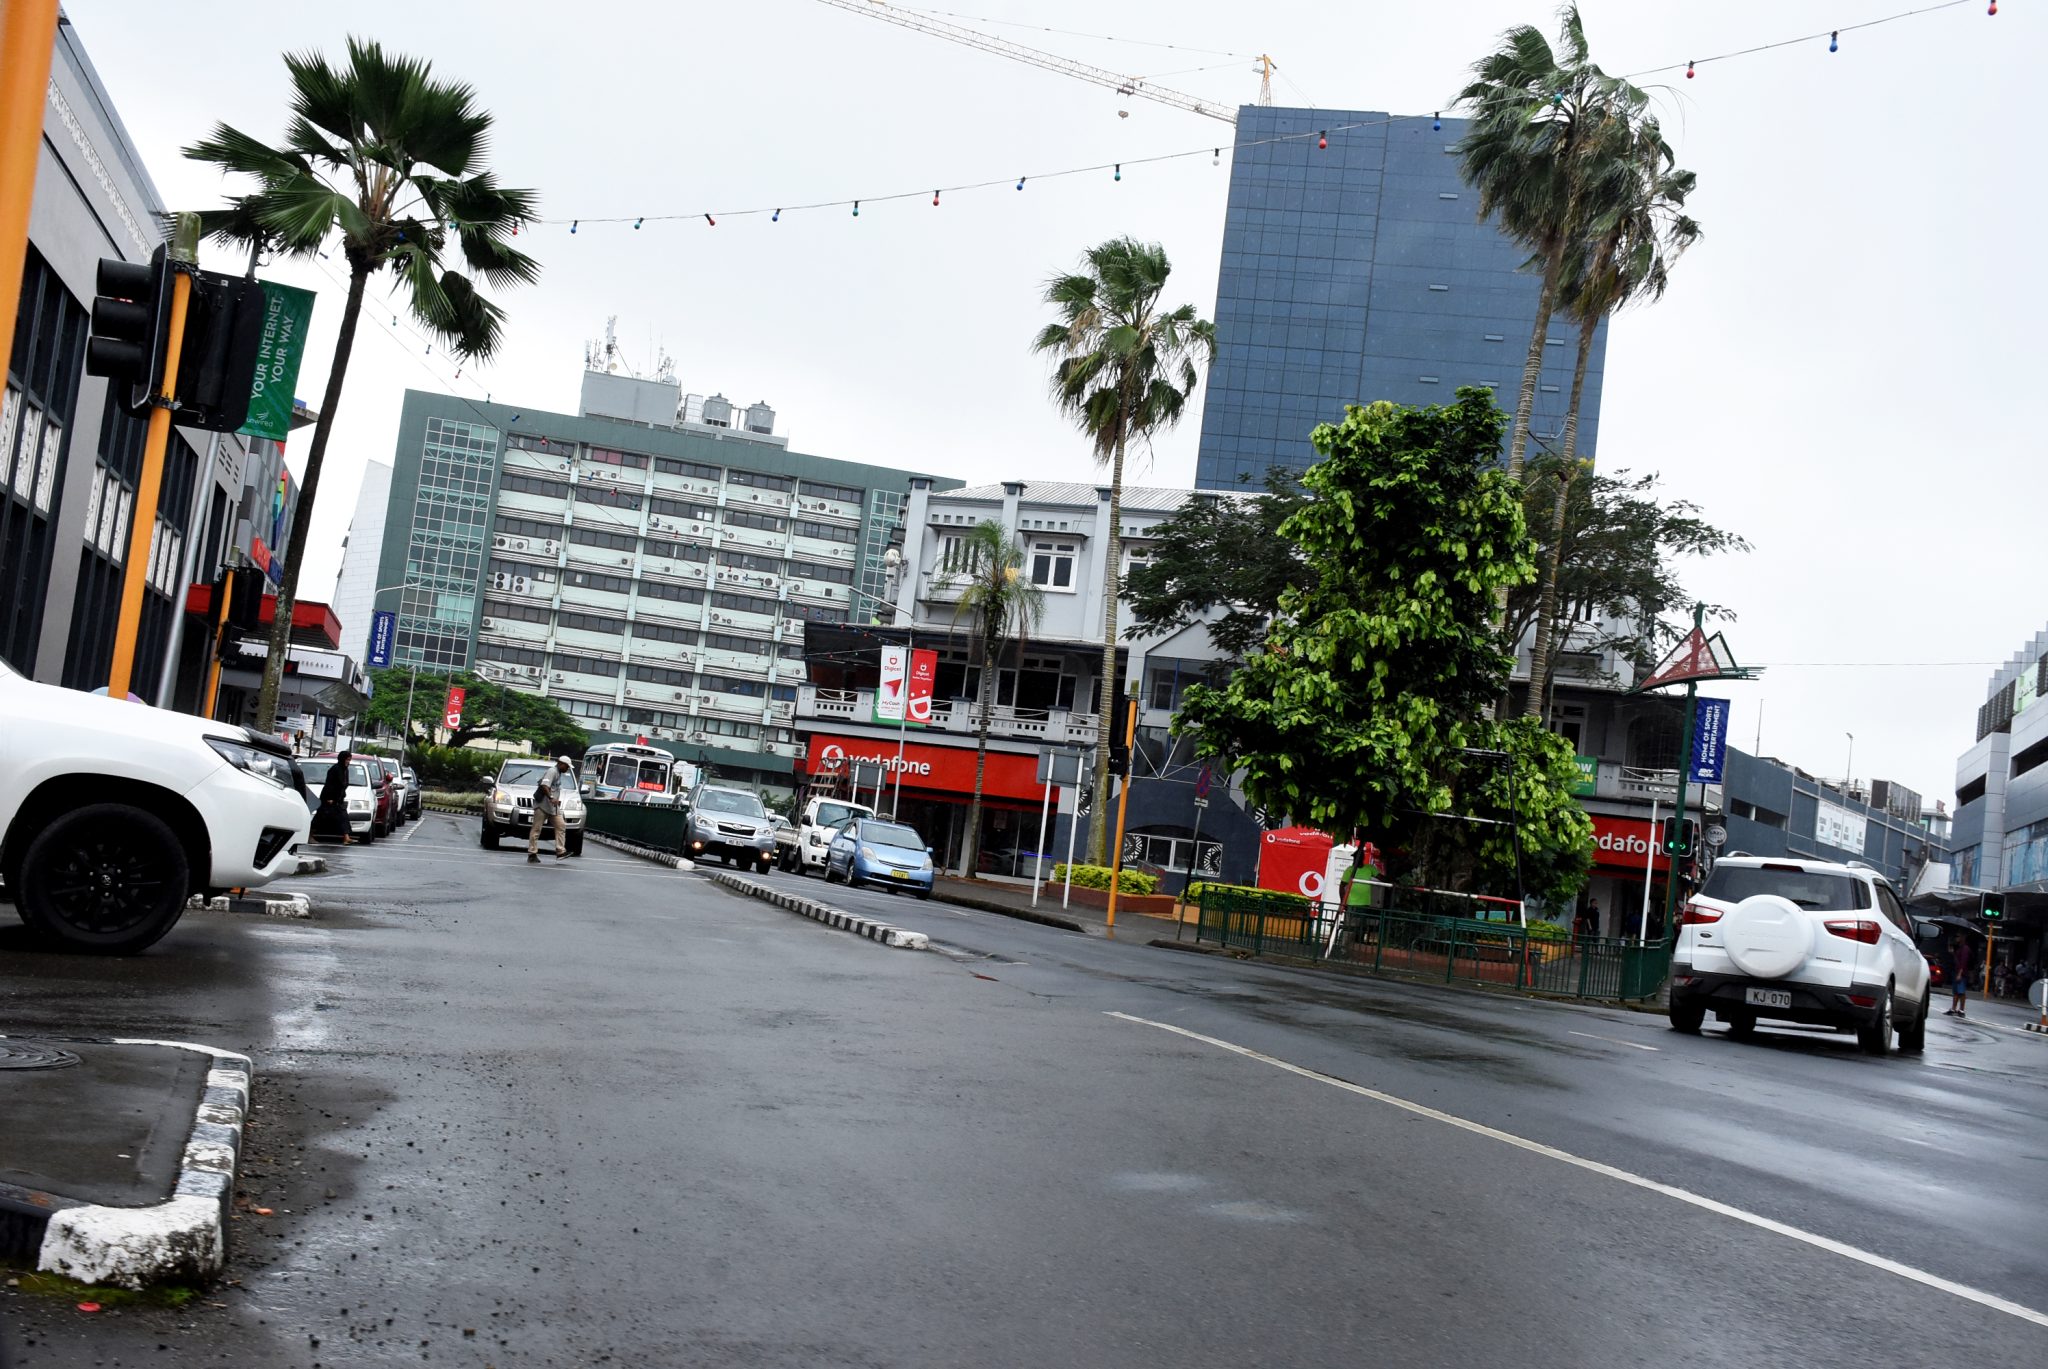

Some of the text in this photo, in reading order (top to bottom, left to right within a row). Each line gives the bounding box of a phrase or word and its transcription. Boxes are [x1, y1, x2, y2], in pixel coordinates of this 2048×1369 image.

[251, 296, 285, 399] YOUR INTERNET,
[271, 315, 294, 384] YOUR WAY
[1701, 705, 1713, 763] HOME OF SPORTS
[1709, 704, 1721, 757] ENTERTAINMENT
[1753, 992, 1790, 1005] KJ 070
